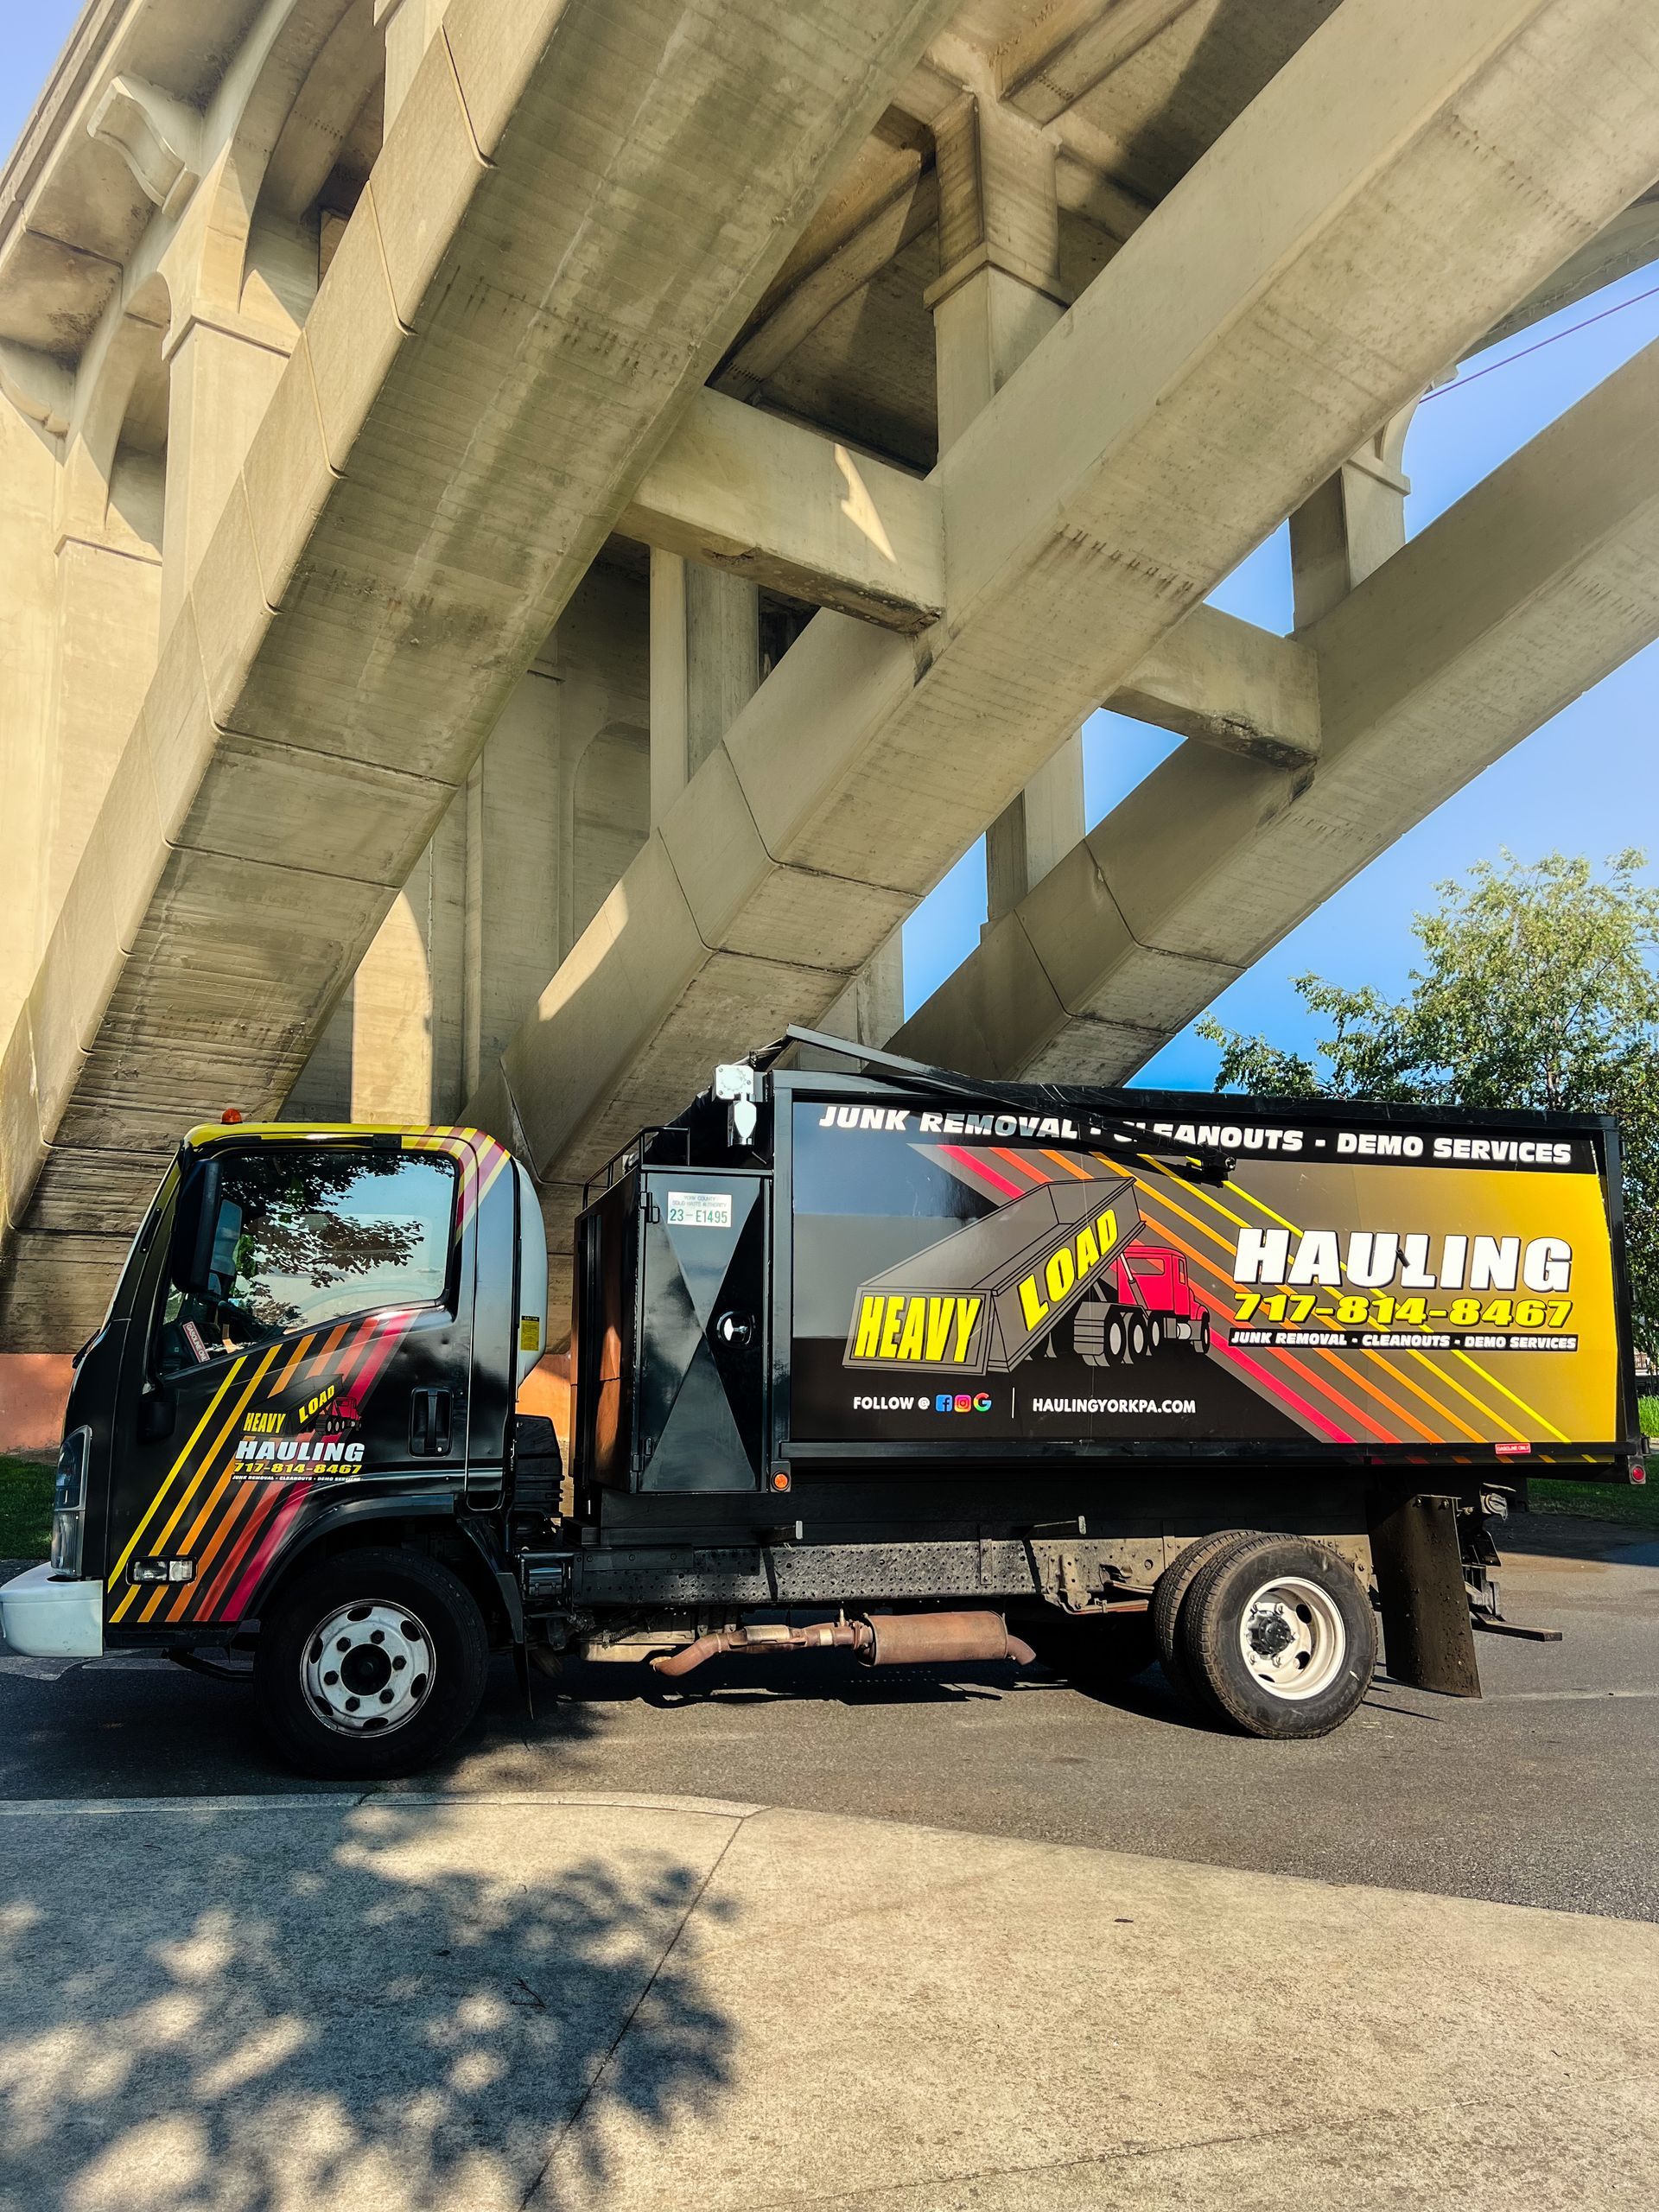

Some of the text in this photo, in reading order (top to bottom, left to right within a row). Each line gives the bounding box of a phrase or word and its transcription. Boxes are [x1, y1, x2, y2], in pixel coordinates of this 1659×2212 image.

[818, 1106, 910, 1131] JUNK
[919, 1111, 1078, 1140] REMOVAL
[1113, 1121, 1304, 1151] EANOUTS
[1337, 1132, 1424, 1157] DEMO
[1433, 1137, 1572, 1164] SERVICES
[1016, 1209, 1119, 1332] LOAD
[1232, 1227, 1573, 1293] HAULING
[1233, 1293, 1573, 1328] 717-814-8467
[854, 1295, 982, 1363] HEAVY
[1231, 1332, 1271, 1344] JUNK
[1274, 1332, 1347, 1346] REMOVAL
[1362, 1334, 1450, 1348] CLEANOUTS
[1464, 1336, 1507, 1349] DEMO
[1509, 1337, 1577, 1351] SERVICES
[298, 1385, 335, 1424] LOAD
[853, 1396, 915, 1410] FOLLOW
[1033, 1398, 1196, 1414] HAULINGYORKPA.COM
[243, 1412, 286, 1433] HEAVY
[234, 1440, 365, 1462] HAULING
[233, 1462, 362, 1474] 717-814-8467
